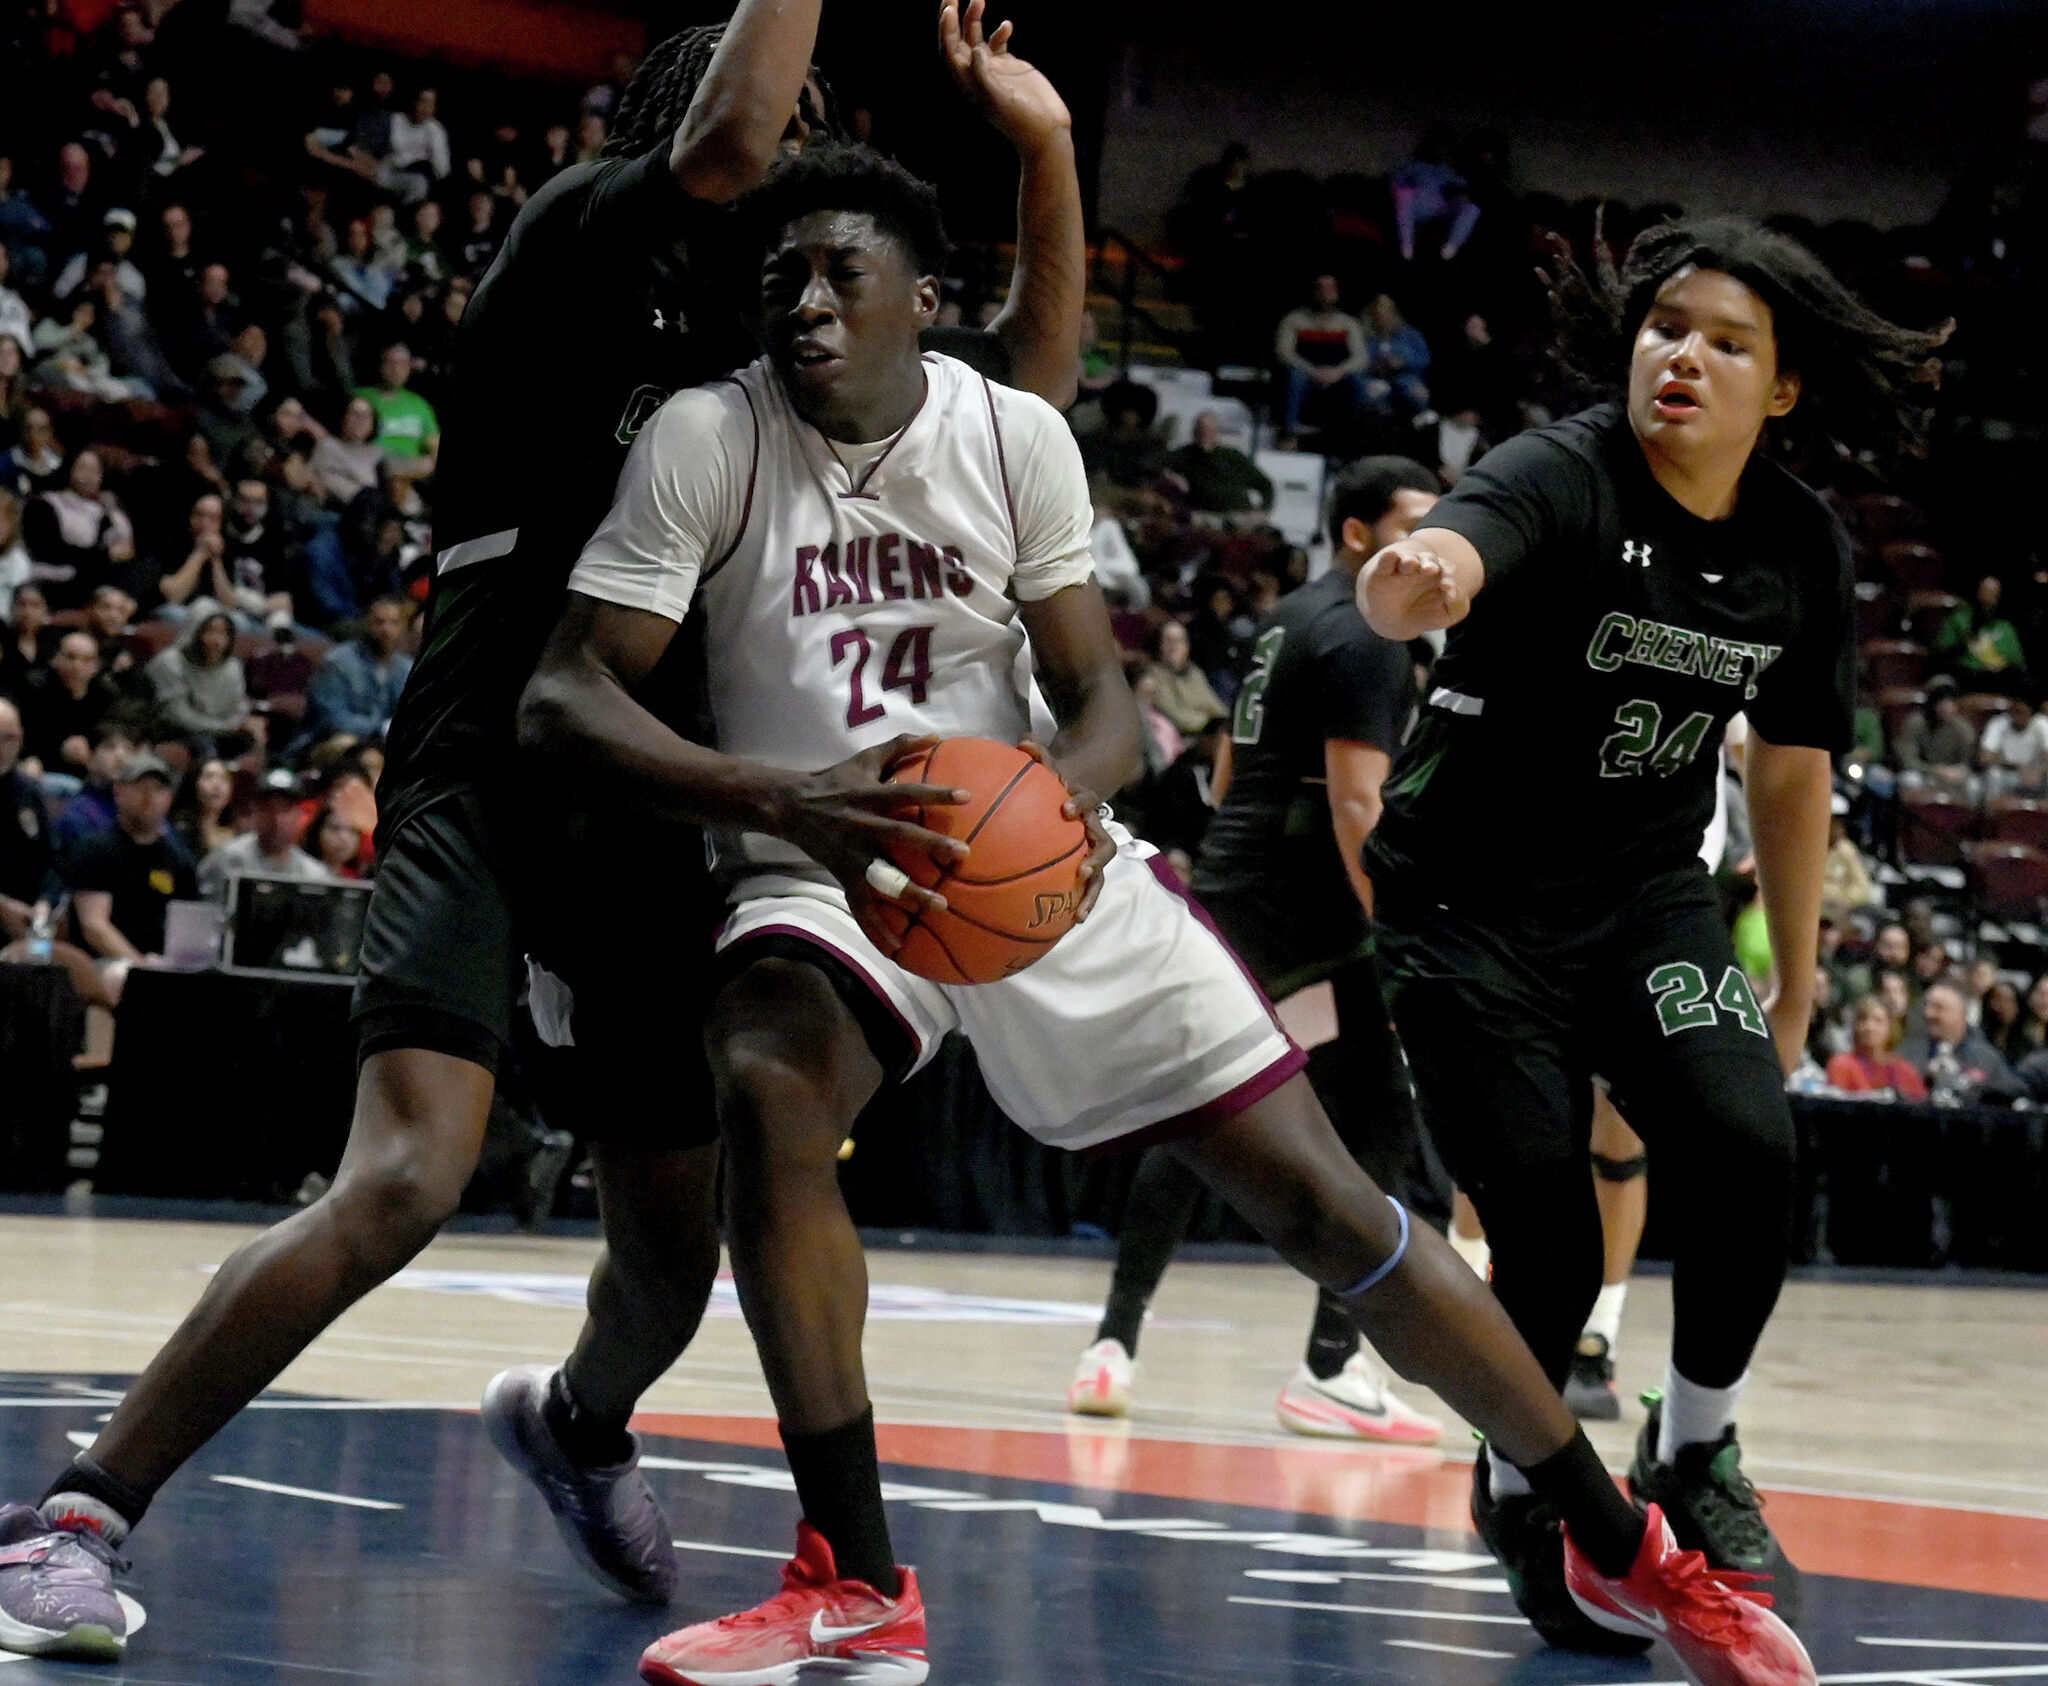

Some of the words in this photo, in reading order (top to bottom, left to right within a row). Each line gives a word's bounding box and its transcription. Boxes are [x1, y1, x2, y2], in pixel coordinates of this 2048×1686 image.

[793, 533, 975, 617] RAVENS
[829, 622, 938, 732] 24
[1587, 611, 1783, 700] CHENEY
[1599, 698, 1715, 778] 24
[1027, 891, 1079, 929] SPA
[1646, 961, 1769, 1039] 24
